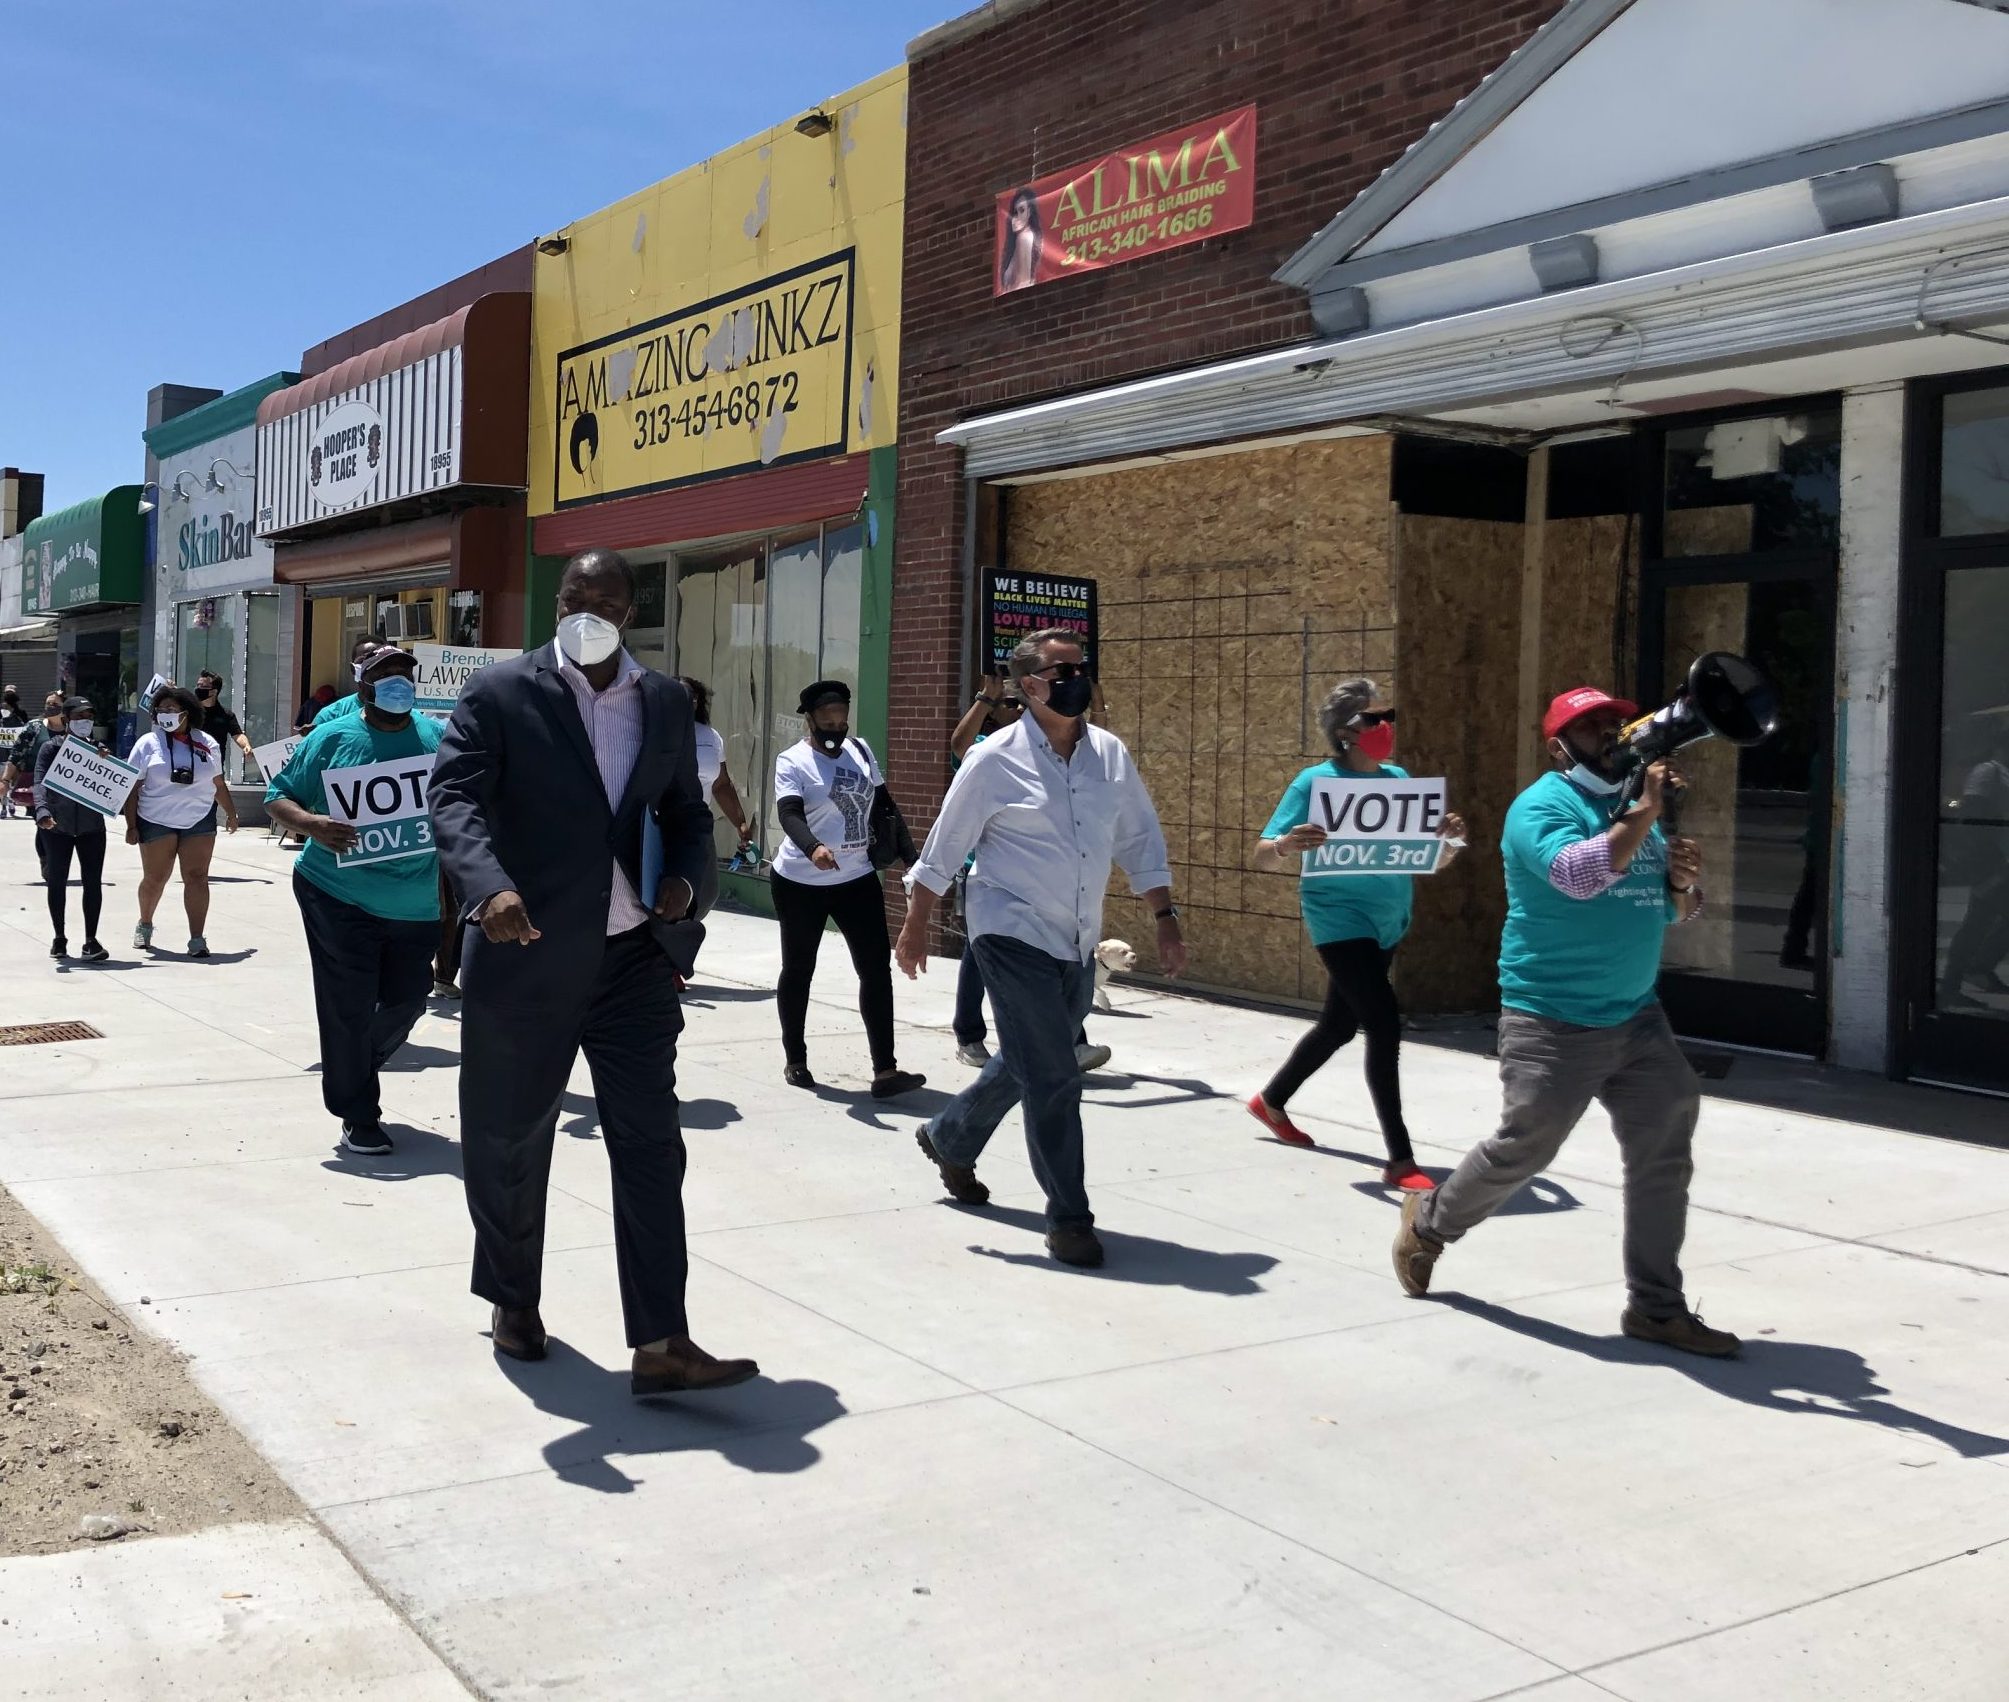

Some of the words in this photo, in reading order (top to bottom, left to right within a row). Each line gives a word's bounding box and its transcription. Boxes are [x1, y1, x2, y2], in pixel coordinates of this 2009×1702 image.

[1051, 128, 1242, 229] ALIMA
[1062, 214, 1117, 243] AFRICAN
[1121, 203, 1153, 225] HAIR
[1158, 180, 1226, 213] BRAIDING
[1061, 204, 1213, 266] 313-340-1666
[324, 423, 366, 458] HOOPER'S
[330, 454, 357, 483] PLACE
[430, 451, 452, 471] 18955
[178, 512, 253, 571] SkinBar
[994, 578, 1019, 592] WE
[1026, 581, 1088, 599] BELIEVE
[994, 593, 1023, 602] BLACK
[1026, 596, 1051, 604] LIVES
[1054, 599, 1087, 608] MATTER
[994, 602, 1009, 611] NO
[1012, 603, 1047, 615] HUMAN
[1058, 608, 1088, 619] ILLEGAL
[994, 613, 1030, 627] LOVE
[1036, 616, 1048, 628] IS
[1055, 619, 1088, 632] LOVE
[442, 650, 495, 665] Brenda
[417, 664, 481, 686] LAWR
[424, 687, 444, 697] U.S.
[62, 748, 82, 764] NO
[83, 759, 129, 789] JUSTICE.
[53, 764, 74, 779] NO
[75, 774, 112, 800] PEACE.
[330, 769, 432, 820] VOT
[1319, 792, 1441, 833] VOTE
[1314, 844, 1376, 867] NOV.
[1384, 844, 1432, 866] 3rd
[1608, 887, 1648, 898] Fighting
